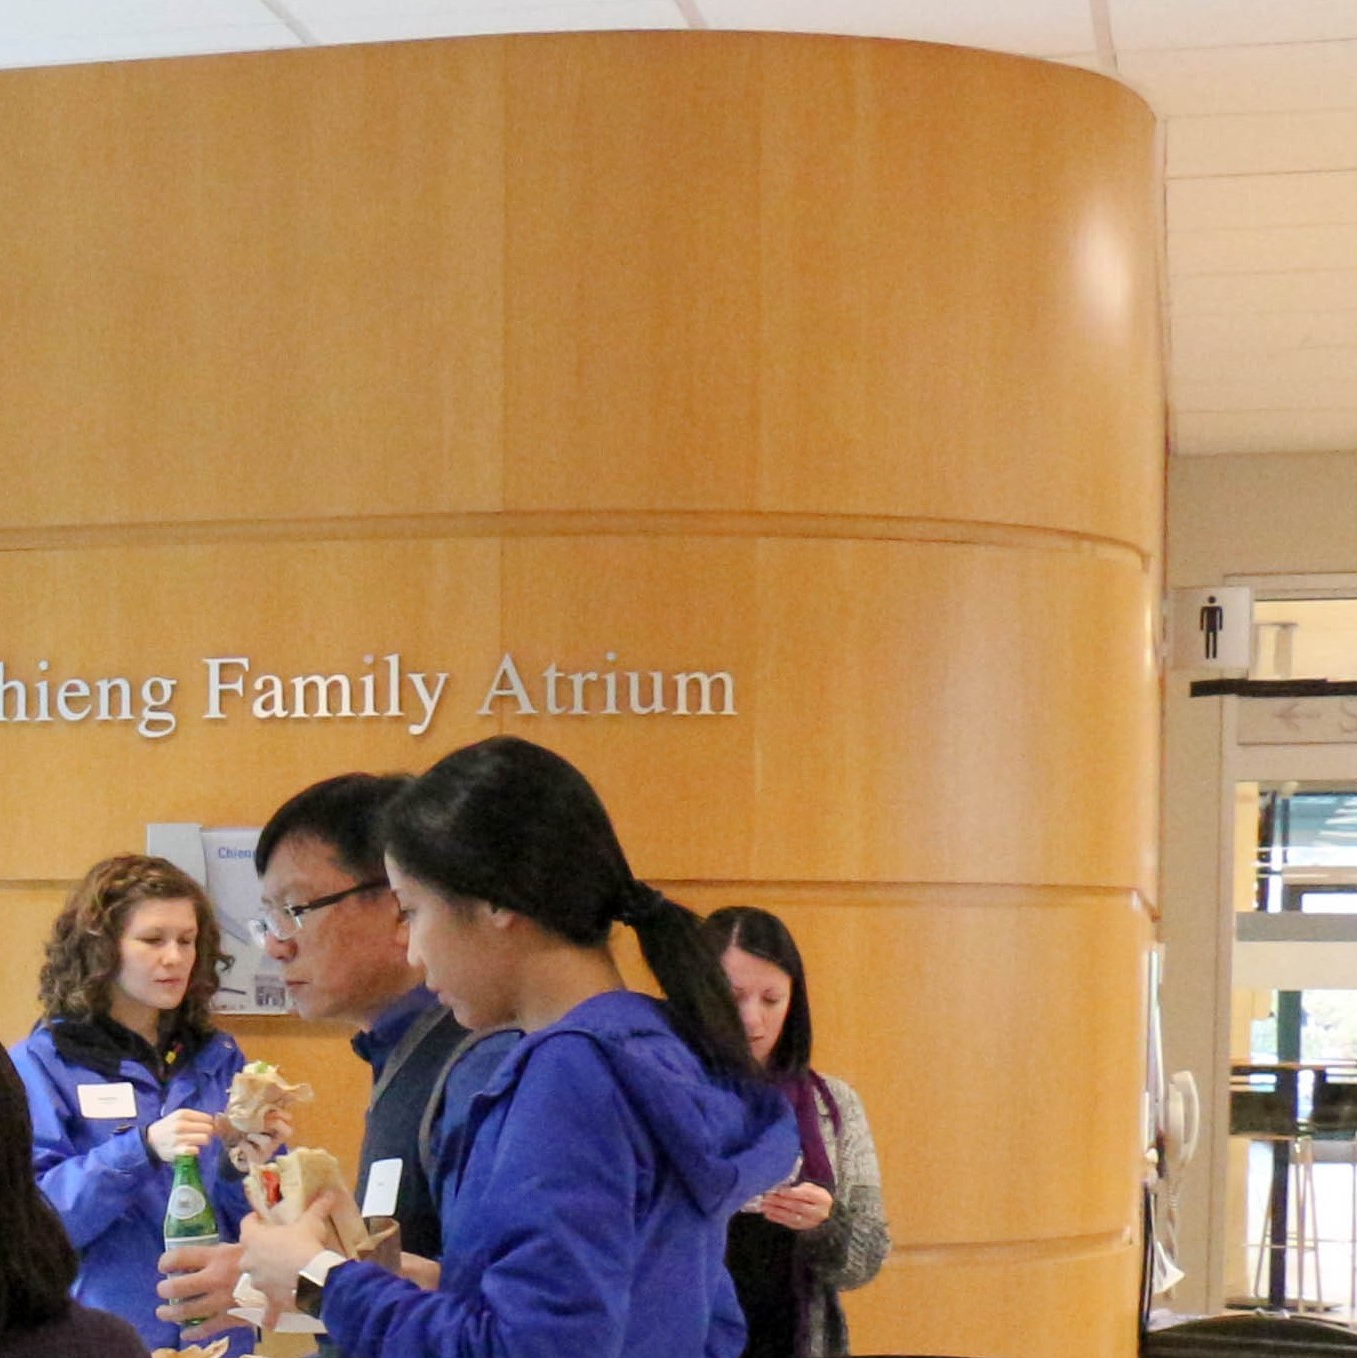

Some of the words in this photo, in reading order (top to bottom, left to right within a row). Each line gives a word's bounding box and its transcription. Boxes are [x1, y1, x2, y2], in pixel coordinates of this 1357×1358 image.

[201, 653, 450, 735] Family
[476, 651, 739, 716] Atrium
[218, 846, 258, 860] Chien
